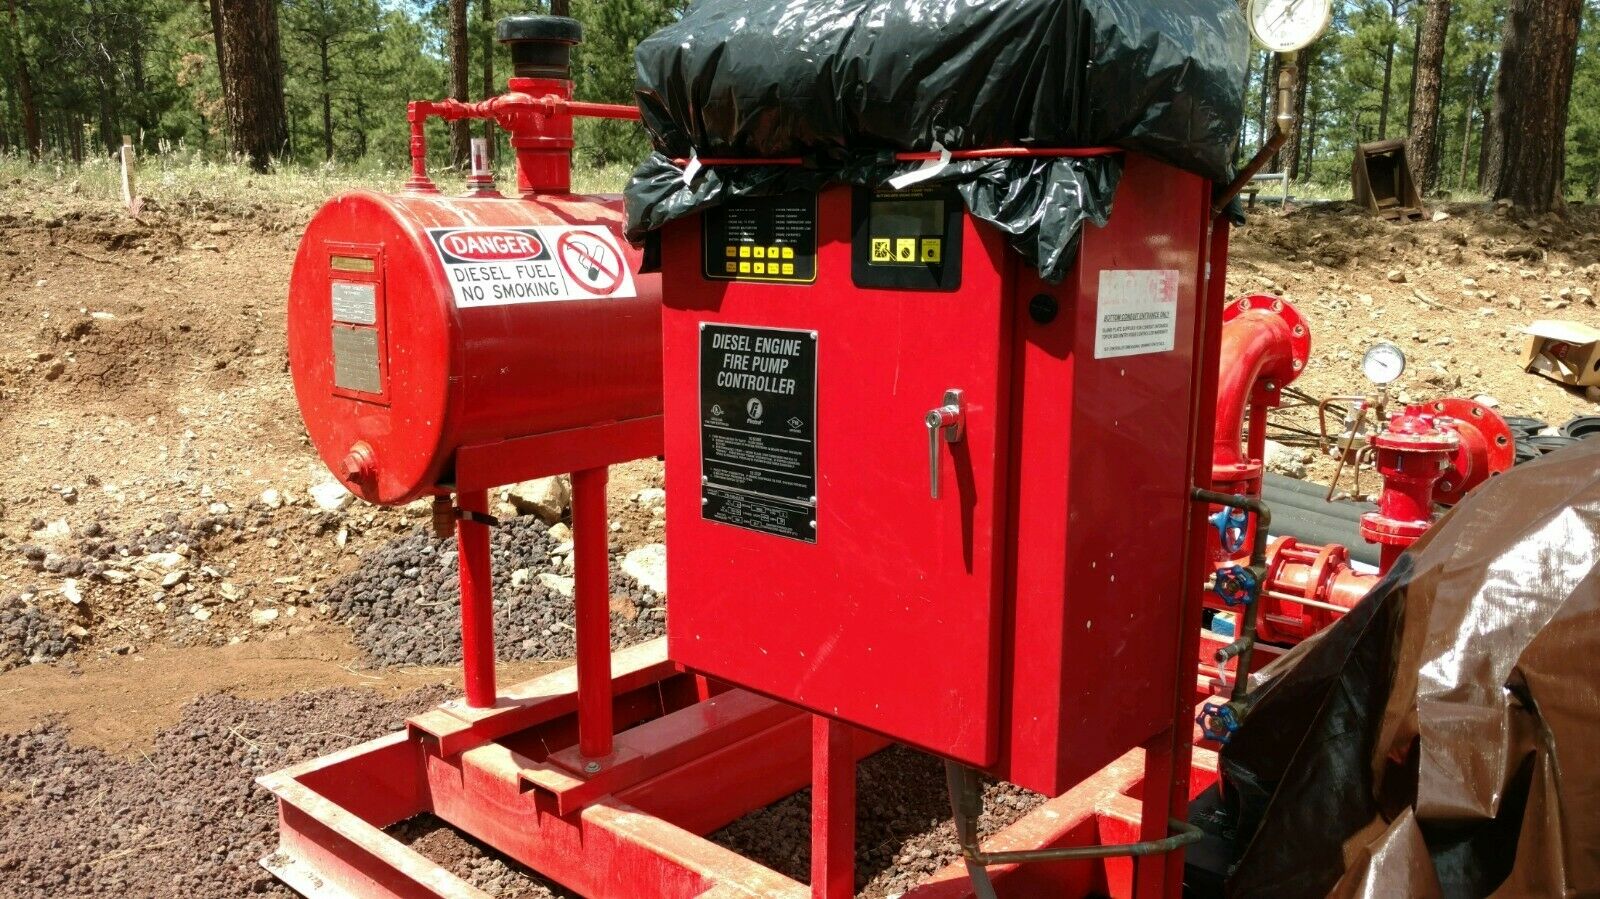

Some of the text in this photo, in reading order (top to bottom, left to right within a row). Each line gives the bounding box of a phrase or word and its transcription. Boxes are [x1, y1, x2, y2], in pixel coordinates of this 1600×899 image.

[450, 235, 535, 254] DANGER
[453, 264, 556, 282] DIESEL FUEL
[461, 281, 559, 301] NO SMOKING
[712, 333, 802, 356] DIESEL ENGINE
[723, 353, 789, 375] FIRE PUMP
[717, 371, 796, 395] CONTROLLER
